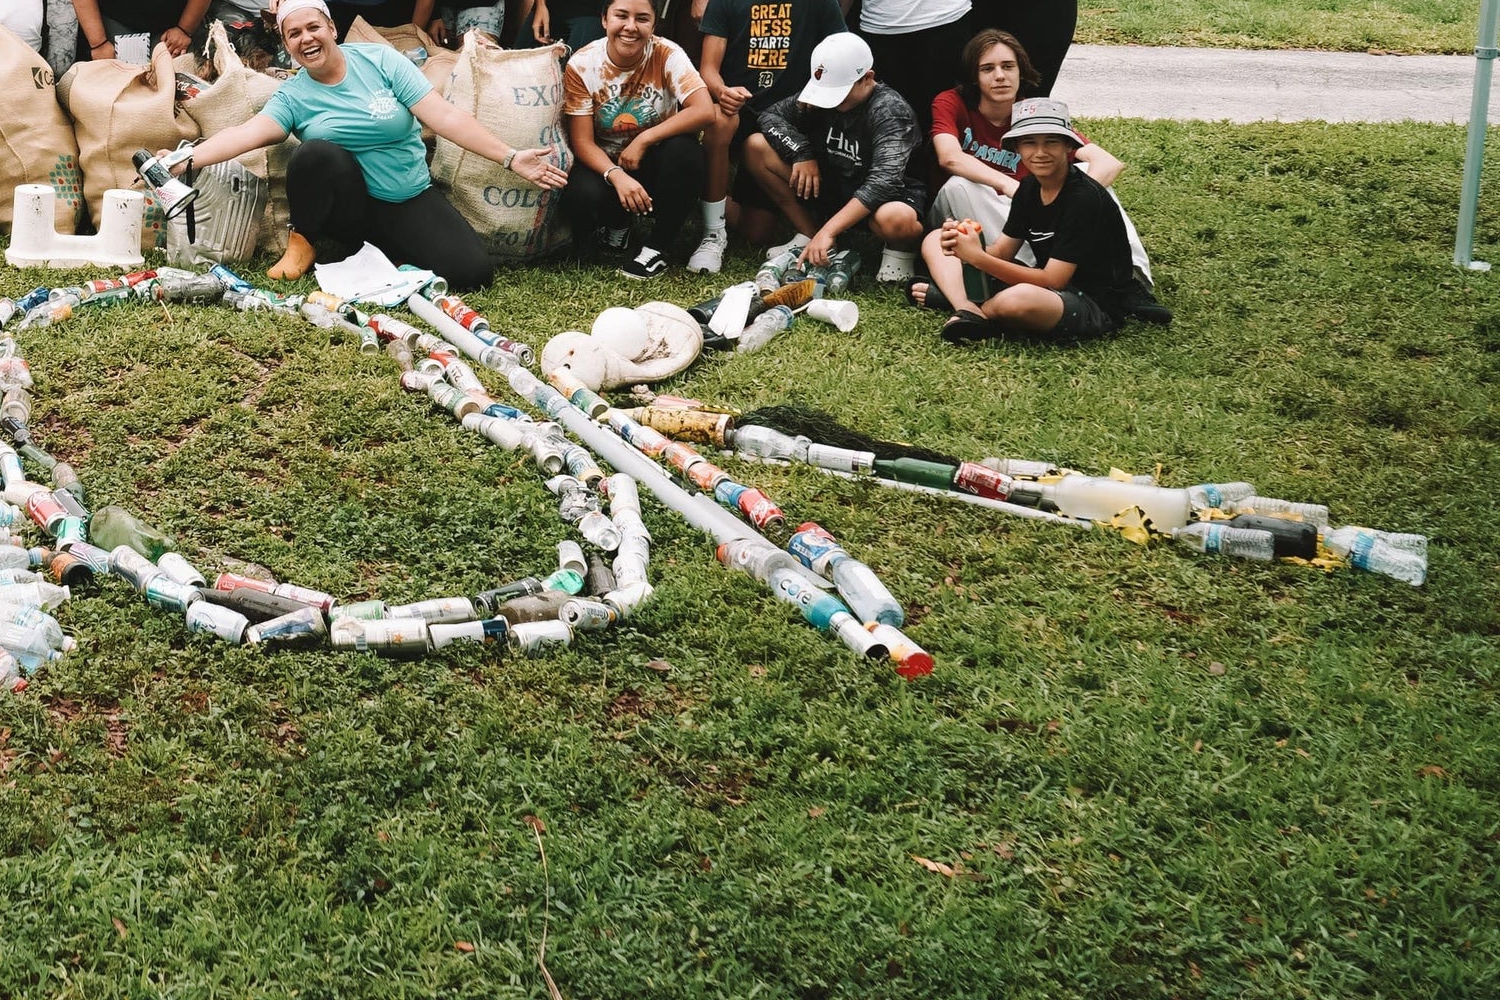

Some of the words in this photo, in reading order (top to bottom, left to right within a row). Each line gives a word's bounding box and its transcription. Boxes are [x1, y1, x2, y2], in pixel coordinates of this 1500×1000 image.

[751, 3, 792, 20] GREAT
[750, 19, 792, 37] NESS
[749, 36, 790, 49] STARTS
[747, 48, 789, 67] HERE
[780, 578, 812, 605] core
